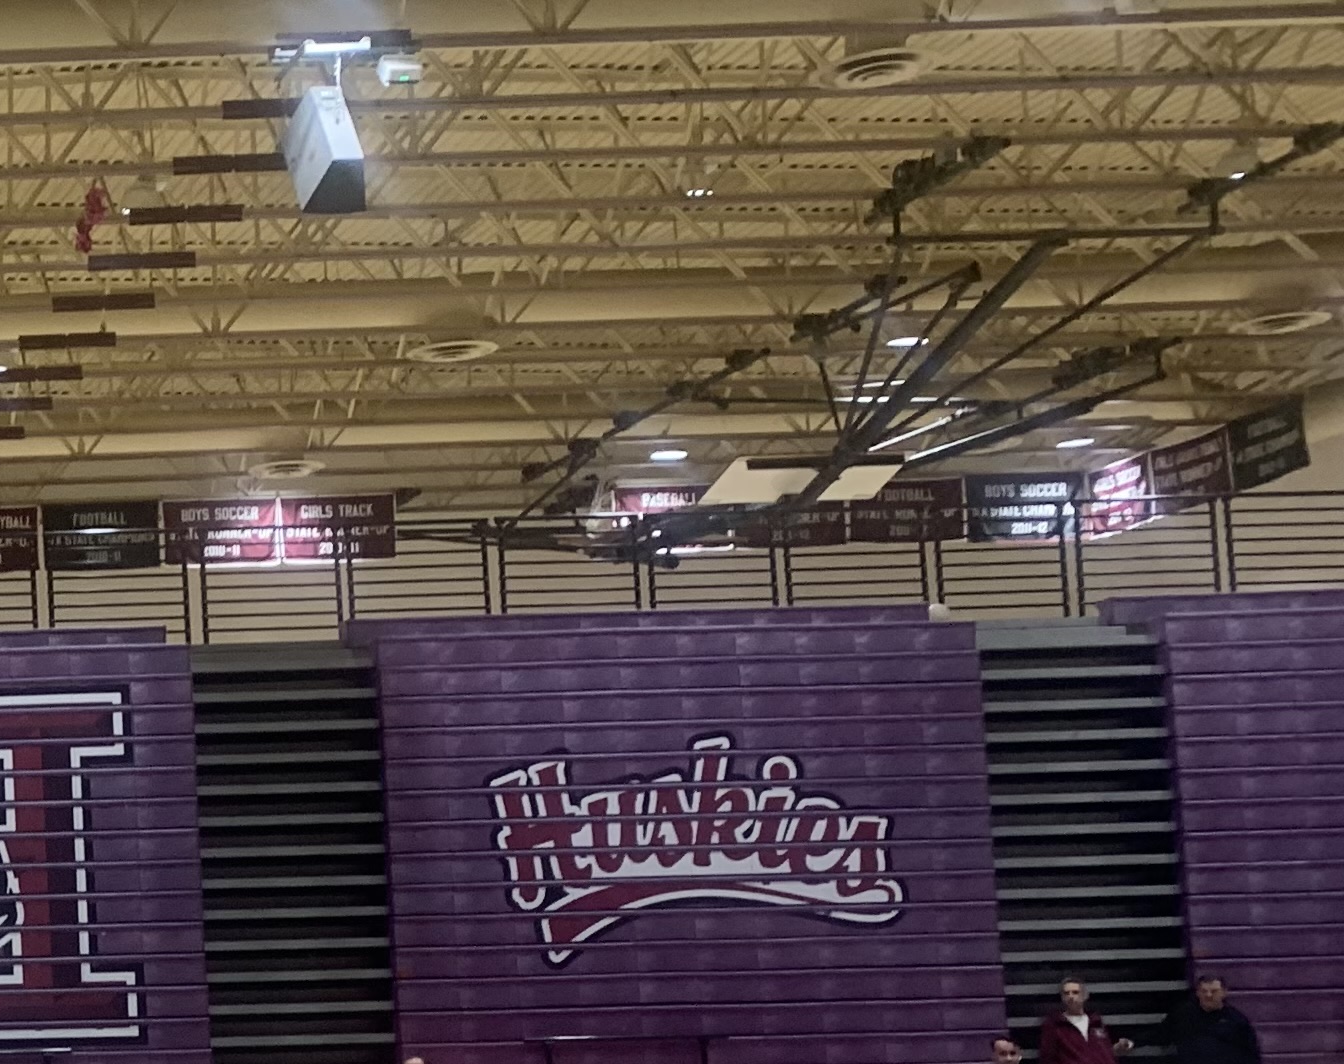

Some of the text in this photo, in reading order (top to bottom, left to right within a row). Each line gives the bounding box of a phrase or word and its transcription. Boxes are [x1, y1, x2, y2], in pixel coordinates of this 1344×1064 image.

[181, 505, 260, 522] BOYS SOCCER
[301, 503, 374, 519] GIRLS TRACK
[489, 736, 904, 938] Huskies
